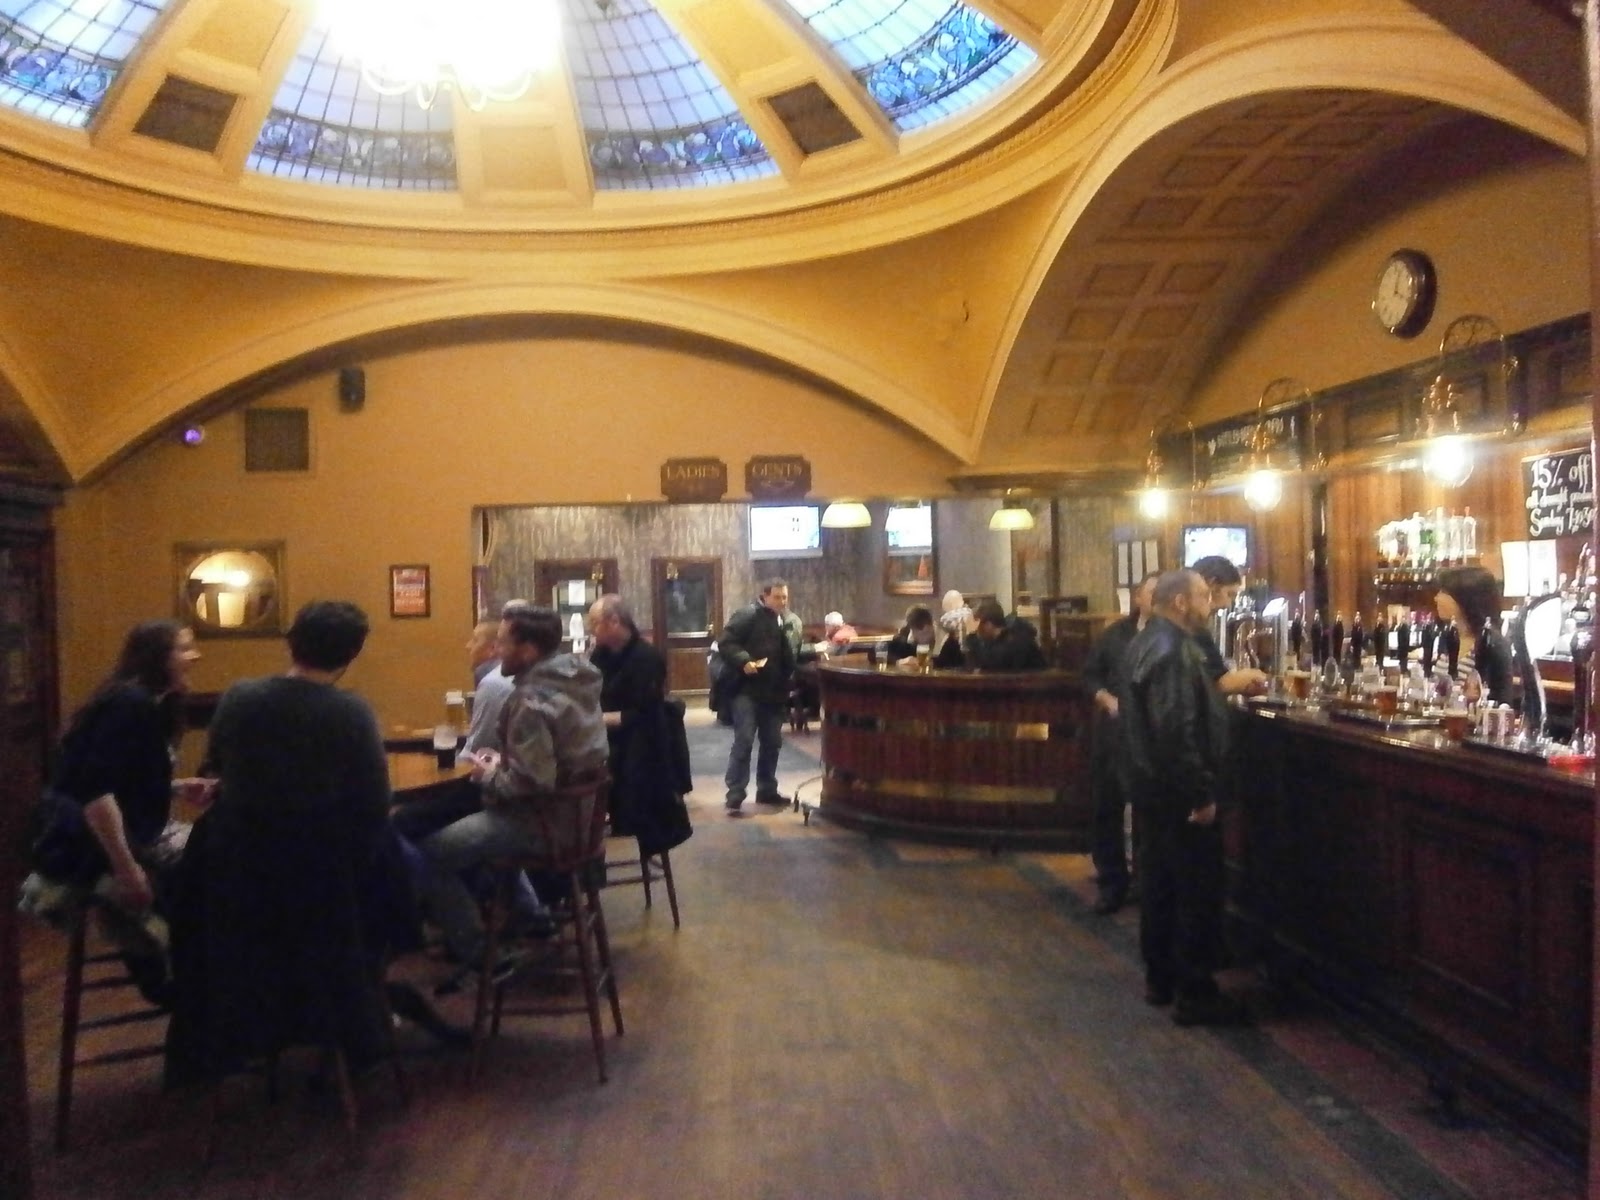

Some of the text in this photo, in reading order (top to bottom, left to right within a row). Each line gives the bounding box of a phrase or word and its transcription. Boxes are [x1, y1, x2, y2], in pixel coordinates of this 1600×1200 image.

[666, 464, 720, 479] LADIES
[752, 462, 802, 479] GENTS
[1531, 454, 1592, 493] 15% off
